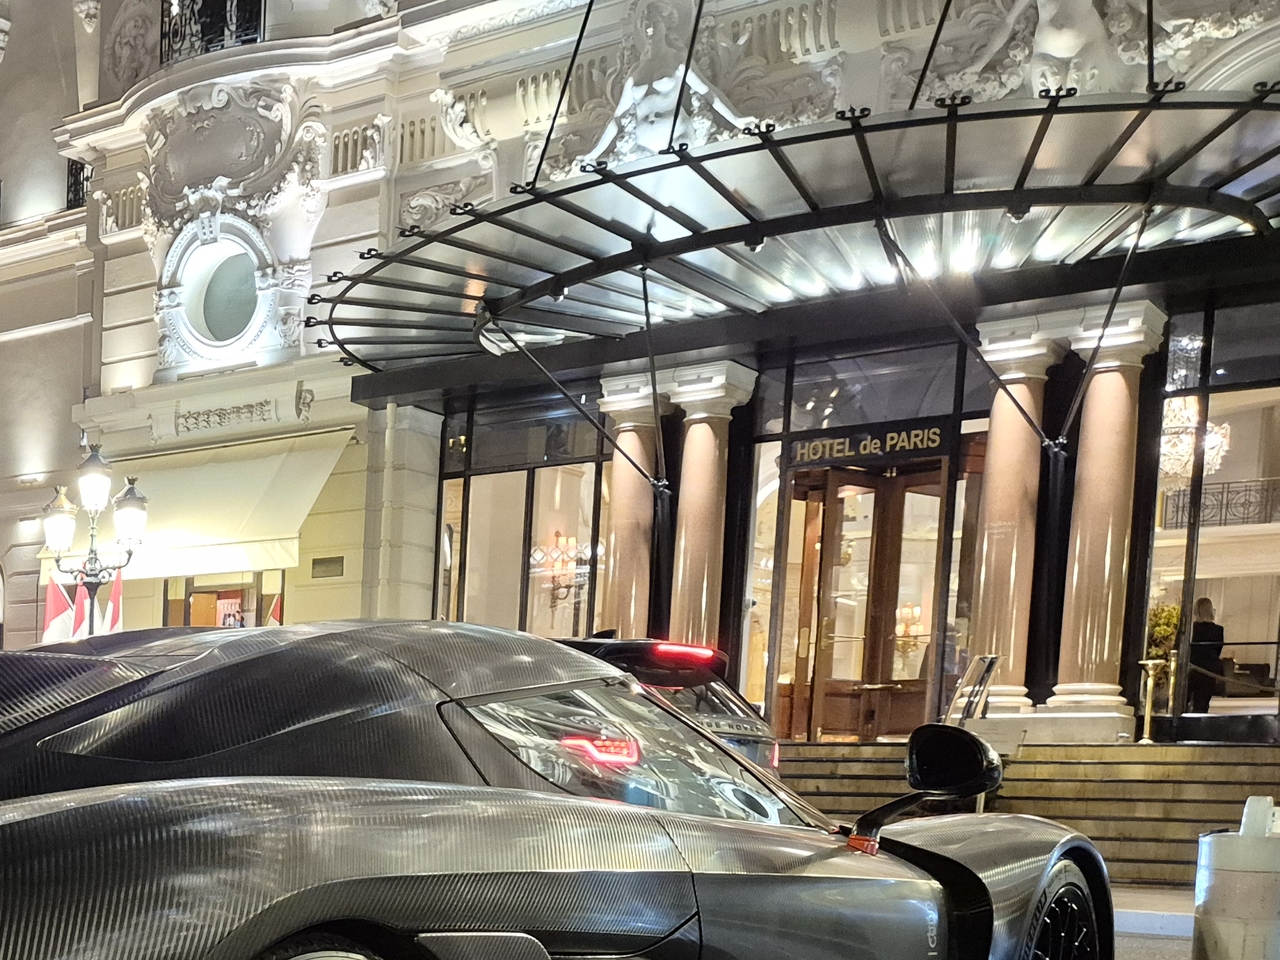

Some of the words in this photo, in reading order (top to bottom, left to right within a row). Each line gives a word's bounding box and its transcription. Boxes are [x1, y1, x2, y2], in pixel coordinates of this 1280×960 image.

[796, 437, 855, 462] HOTEL
[859, 435, 881, 455] de
[885, 427, 941, 452] PARIS
